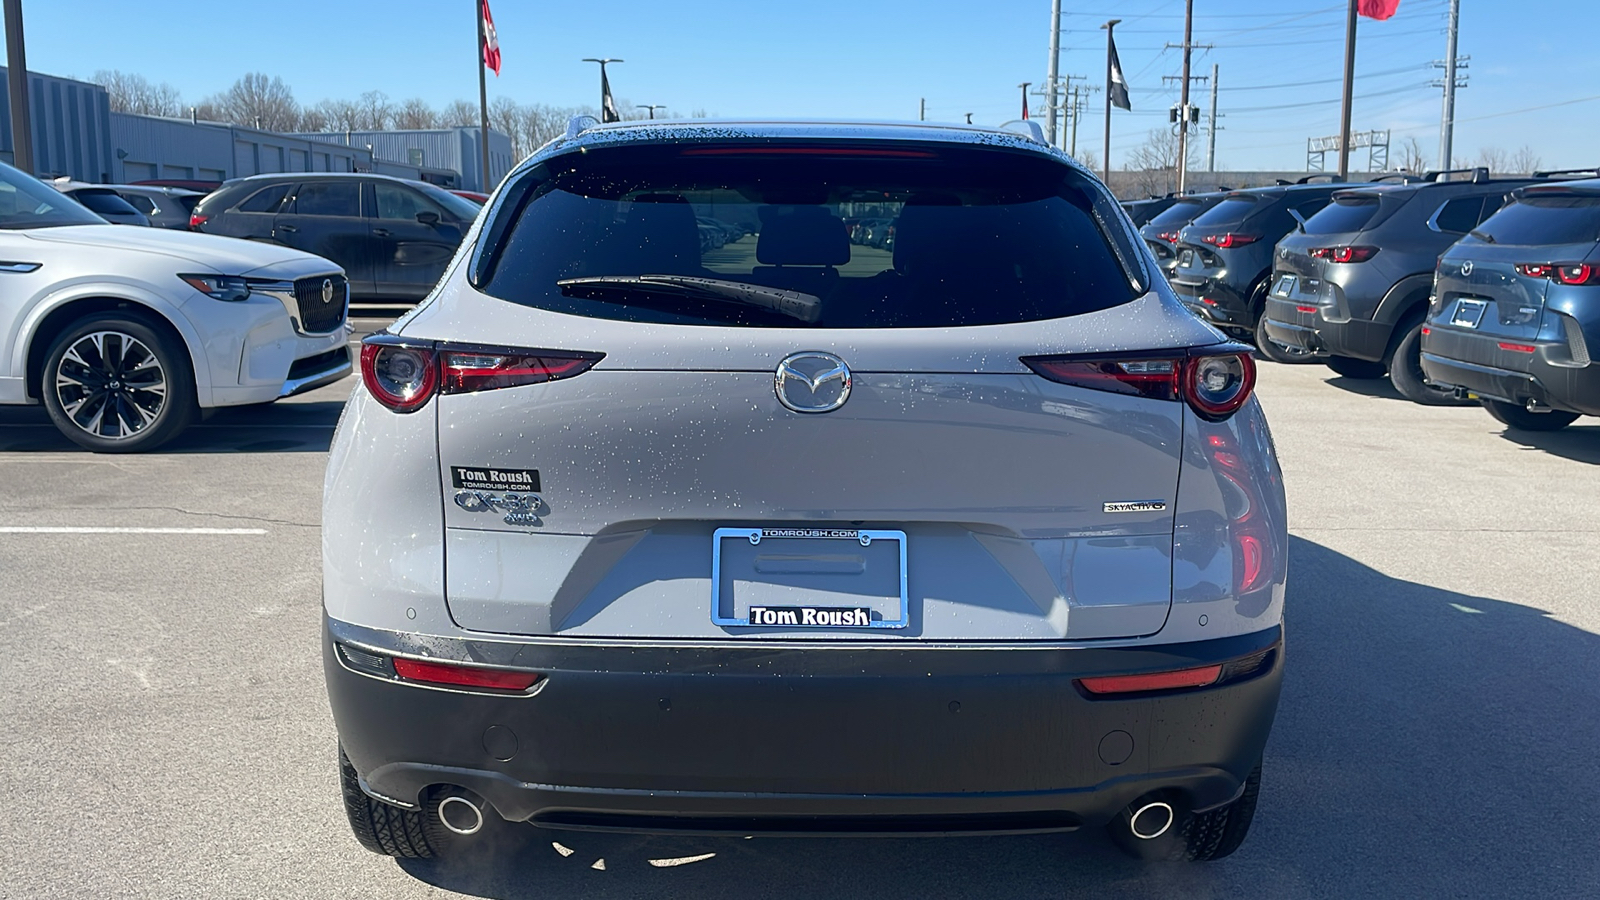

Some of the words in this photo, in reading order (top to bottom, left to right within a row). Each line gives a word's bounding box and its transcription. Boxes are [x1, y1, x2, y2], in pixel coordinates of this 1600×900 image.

[457, 468, 487, 481] Tom
[489, 470, 533, 483] Roush
[462, 481, 531, 491] TOMROUSH.COM
[454, 489, 541, 512] CX-30
[763, 529, 858, 538] TOMROUSH.COM
[750, 607, 798, 624] Tom
[801, 607, 869, 626] Roush
